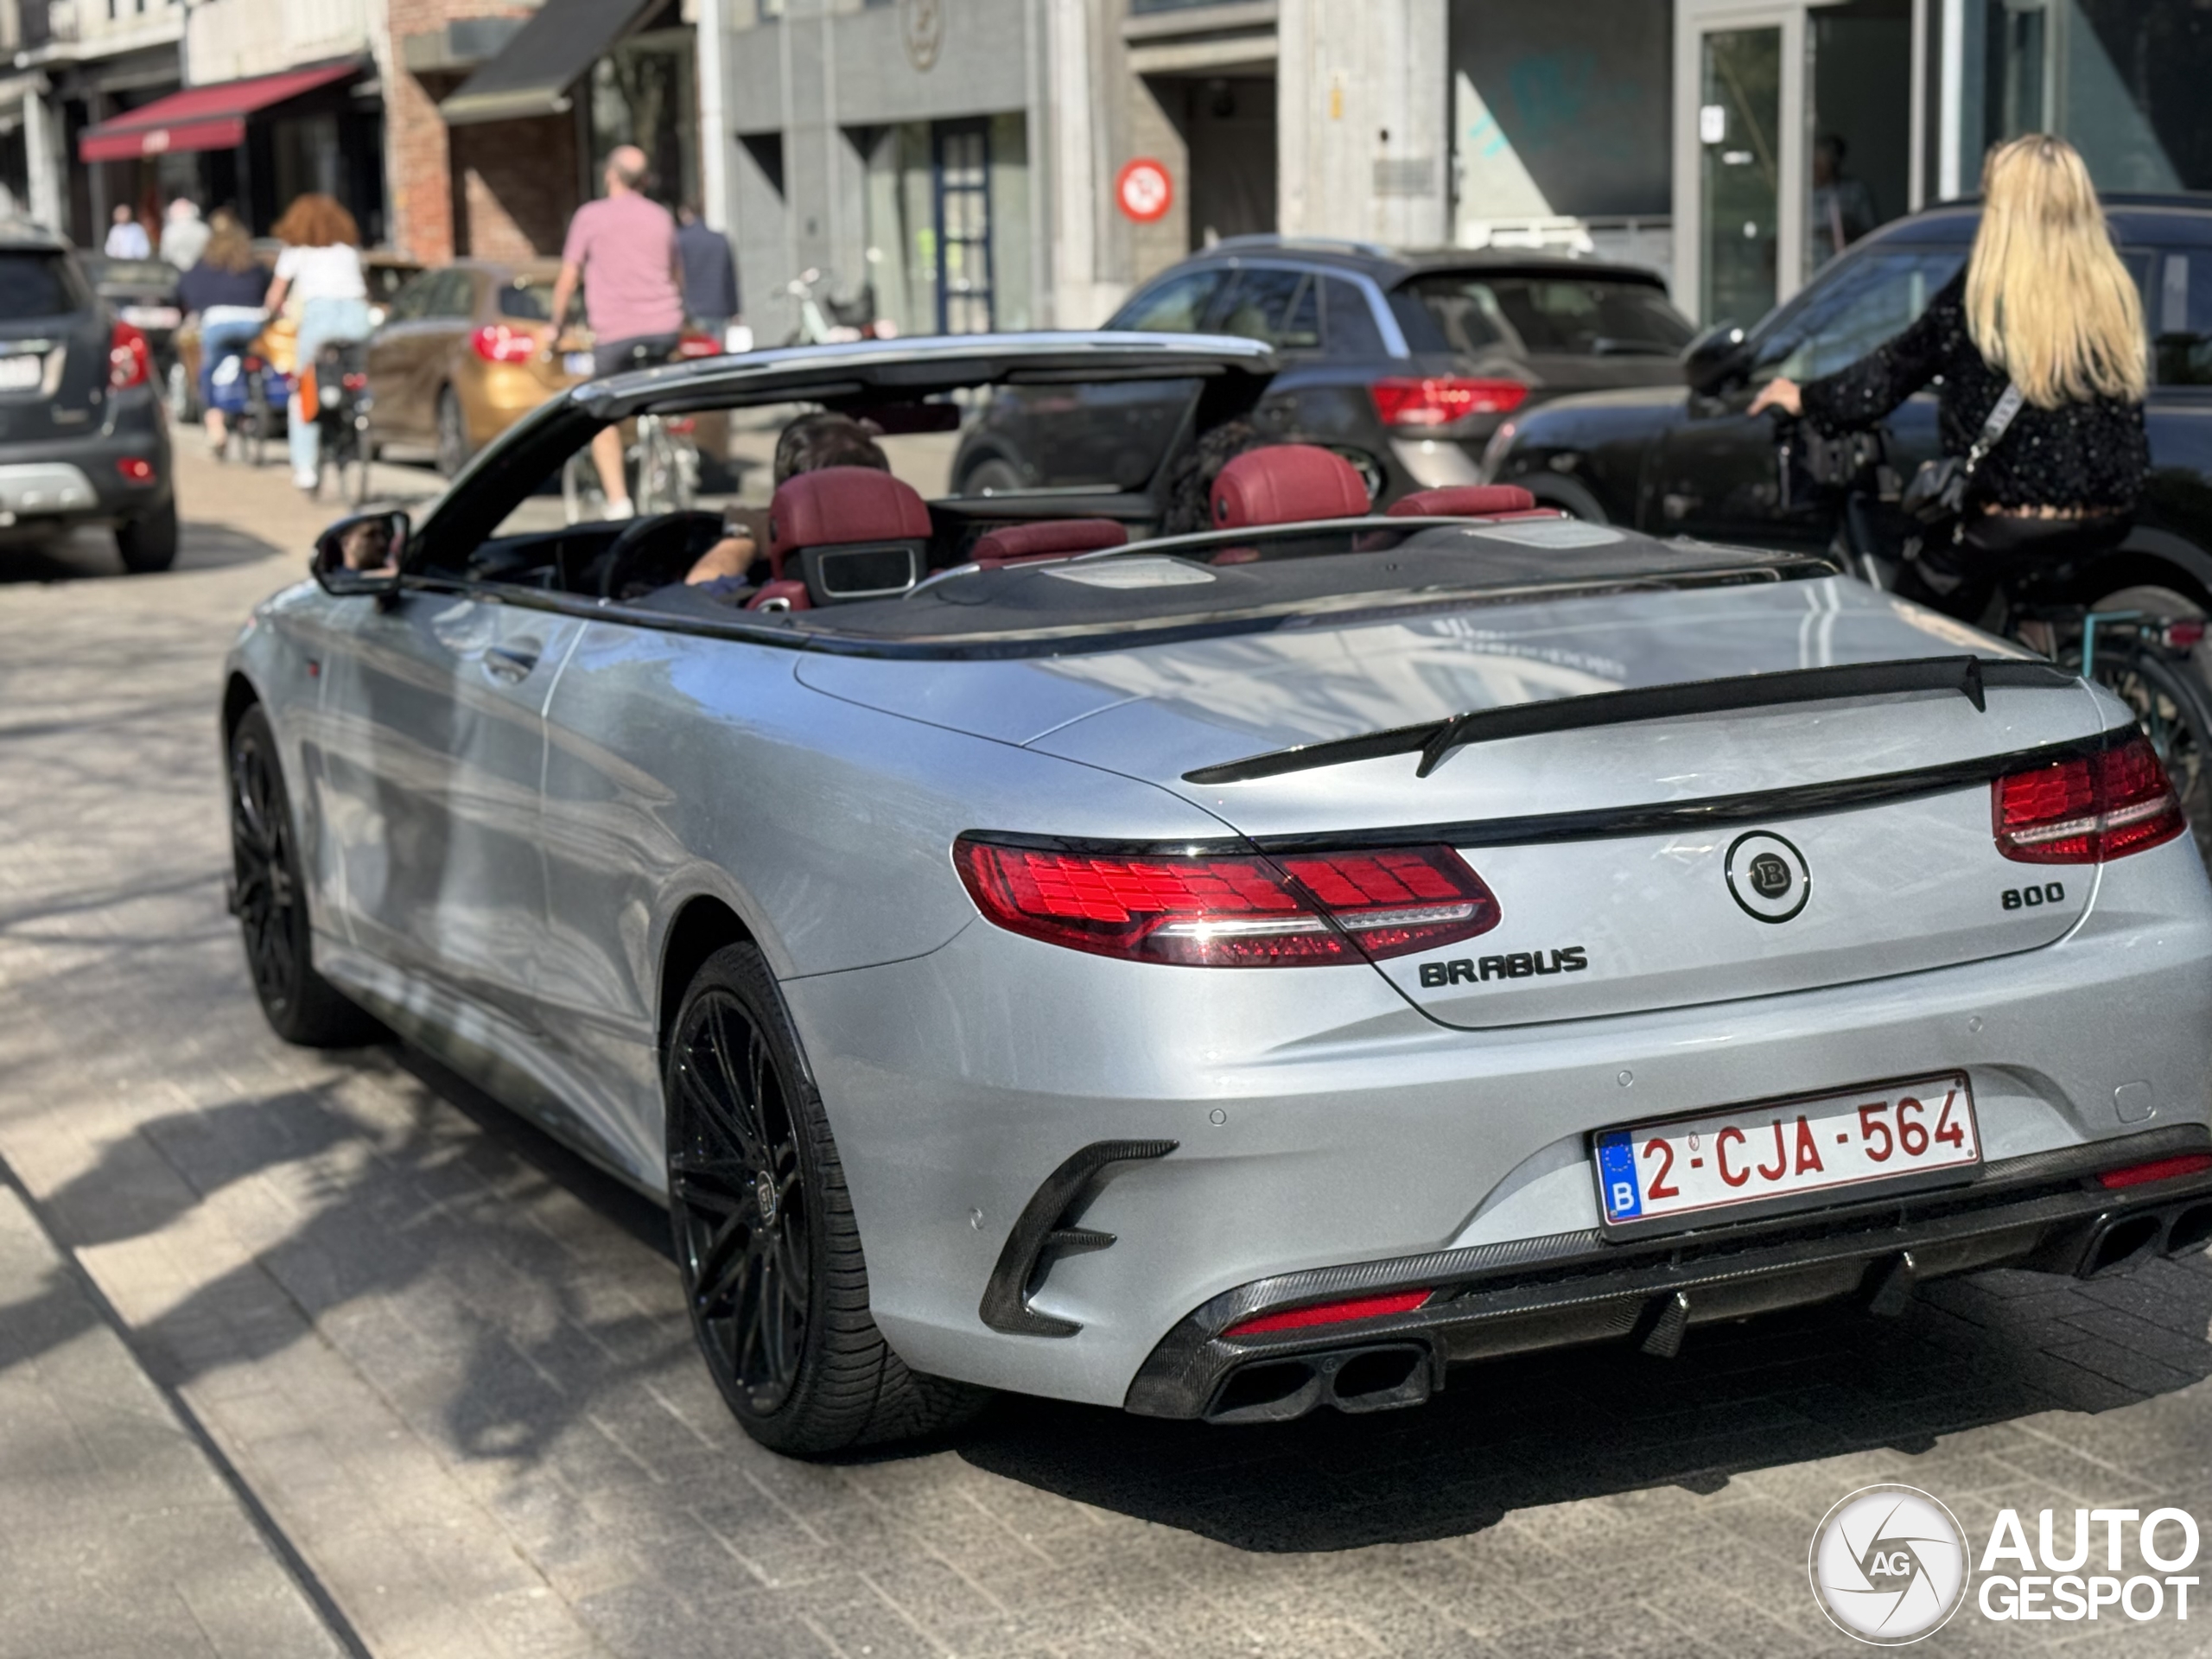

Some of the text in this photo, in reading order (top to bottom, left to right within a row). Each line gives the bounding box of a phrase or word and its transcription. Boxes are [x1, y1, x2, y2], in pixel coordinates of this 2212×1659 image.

[1757, 860, 1788, 889] B
[2001, 881, 2065, 911] 800
[1419, 945, 1588, 988] BRABUS
[1643, 1090, 1965, 1200] 2-CJA-564
[1612, 1182, 1635, 1211] B
